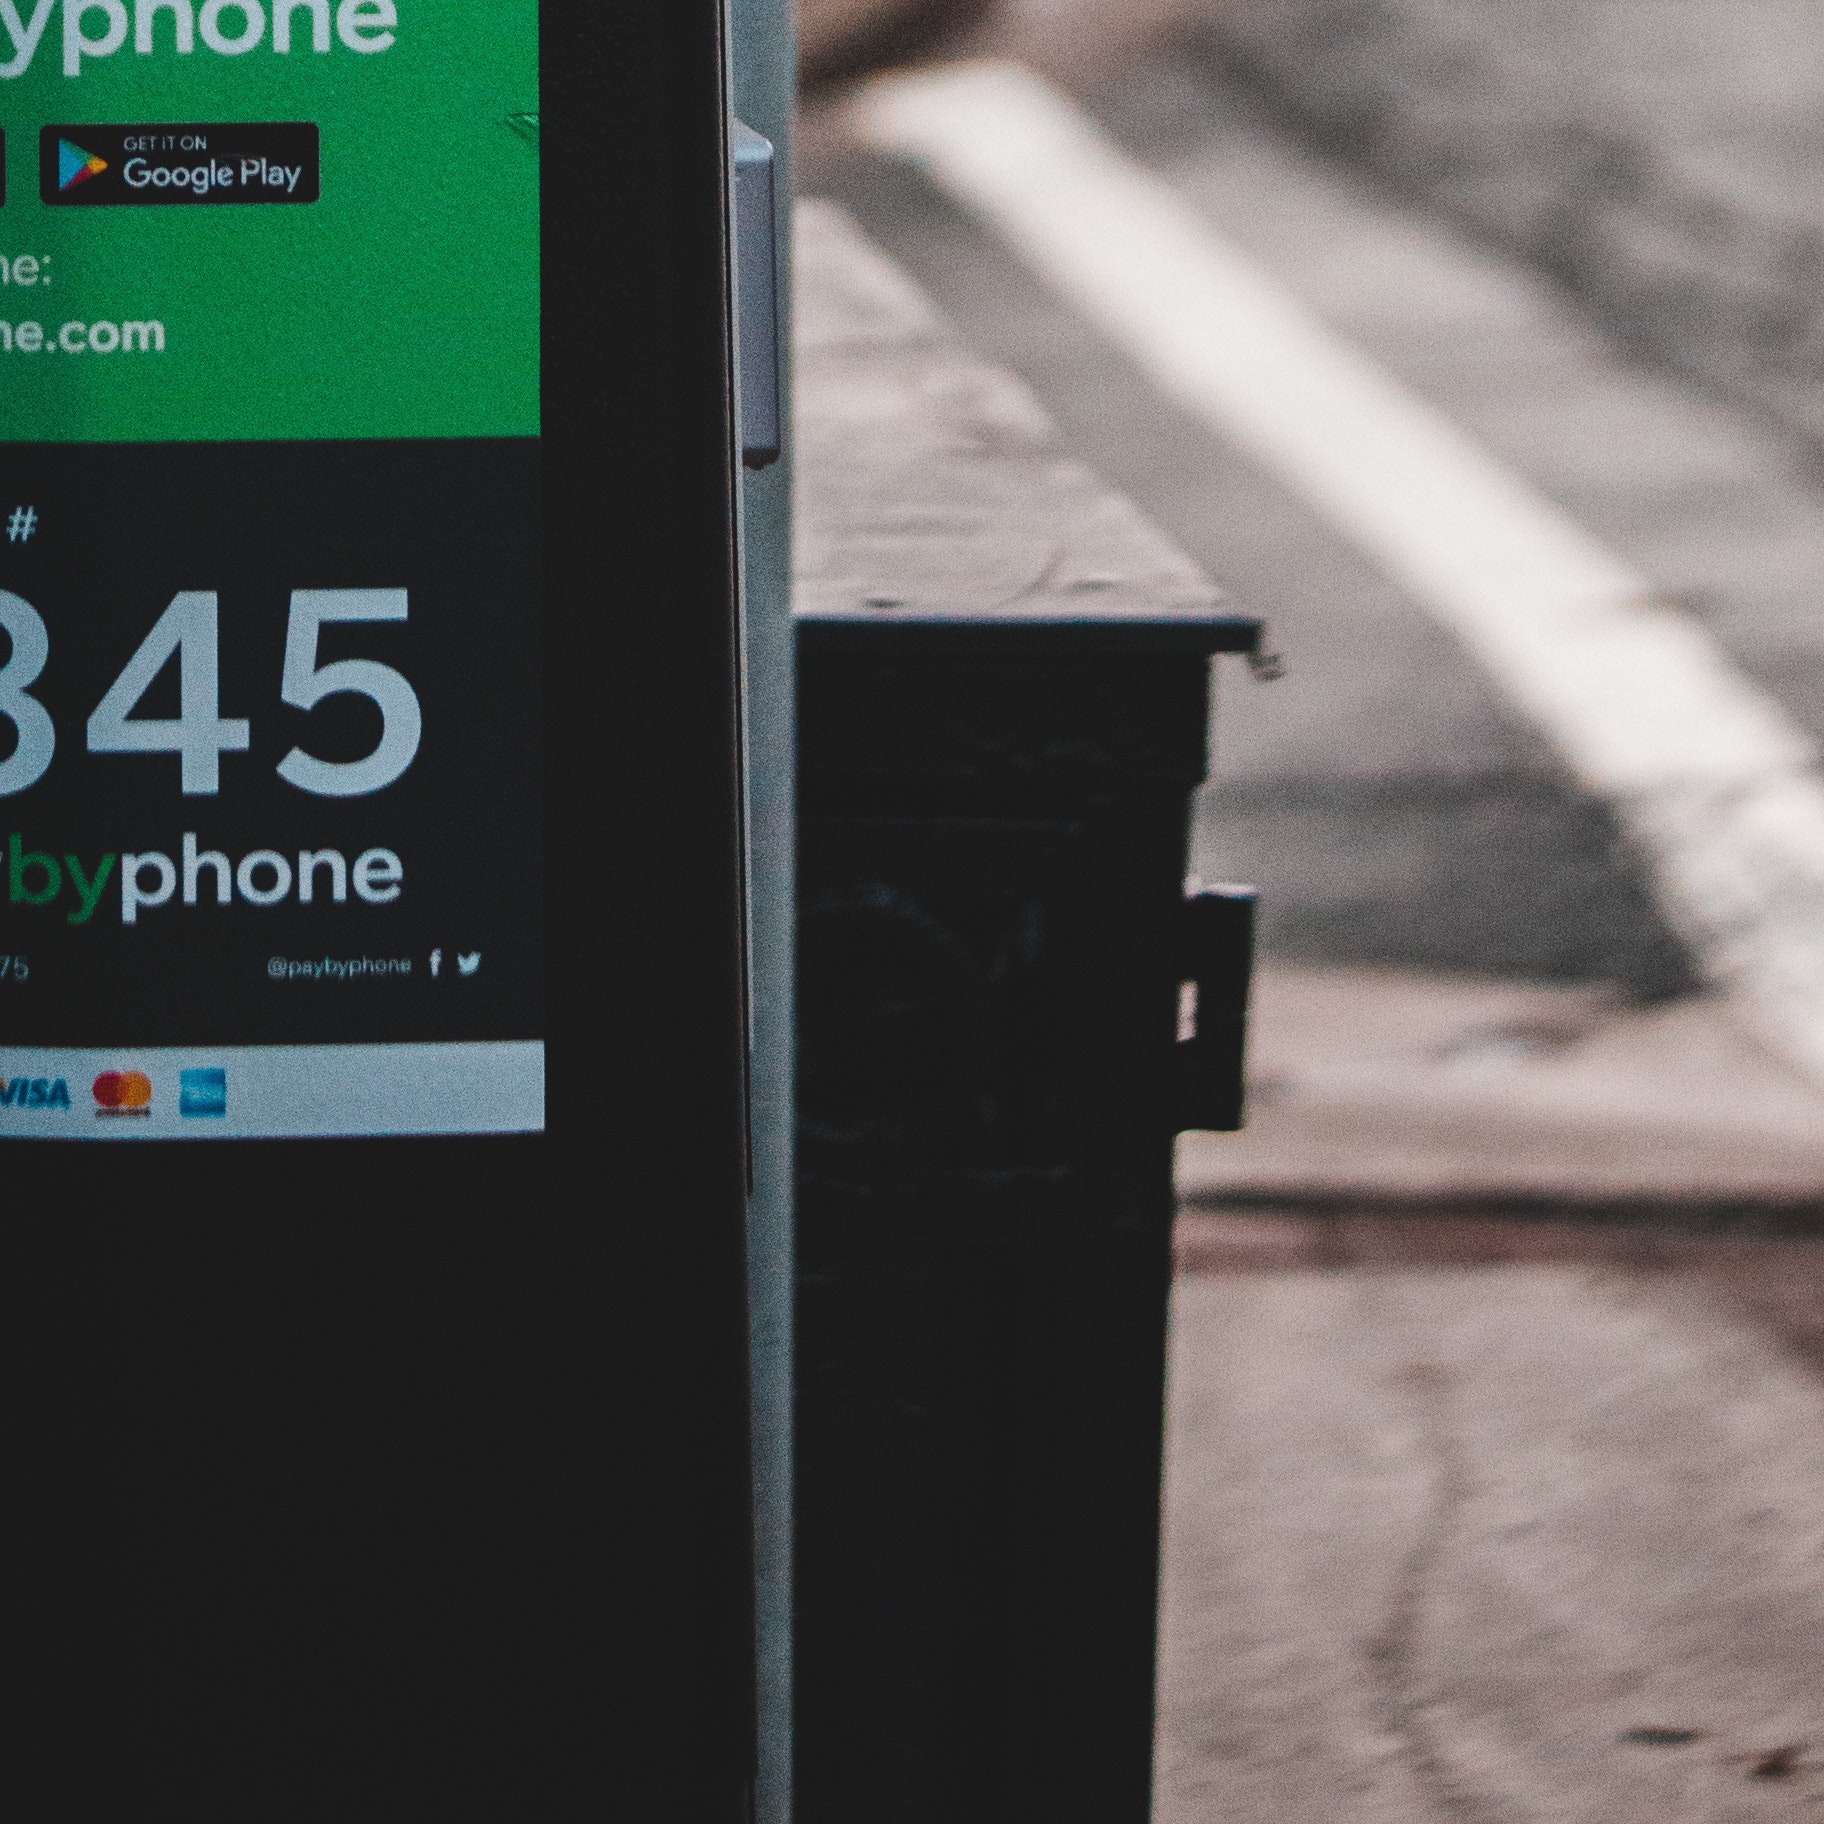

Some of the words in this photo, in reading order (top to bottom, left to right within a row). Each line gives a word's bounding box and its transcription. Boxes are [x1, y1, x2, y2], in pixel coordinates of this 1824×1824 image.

[123, 135, 158, 152] GET
[161, 135, 175, 151] IT
[179, 135, 208, 151] ON
[123, 156, 234, 195] Google
[240, 156, 302, 193] Play
[6, 505, 39, 544] #
[267, 954, 413, 981] @paybyphone
